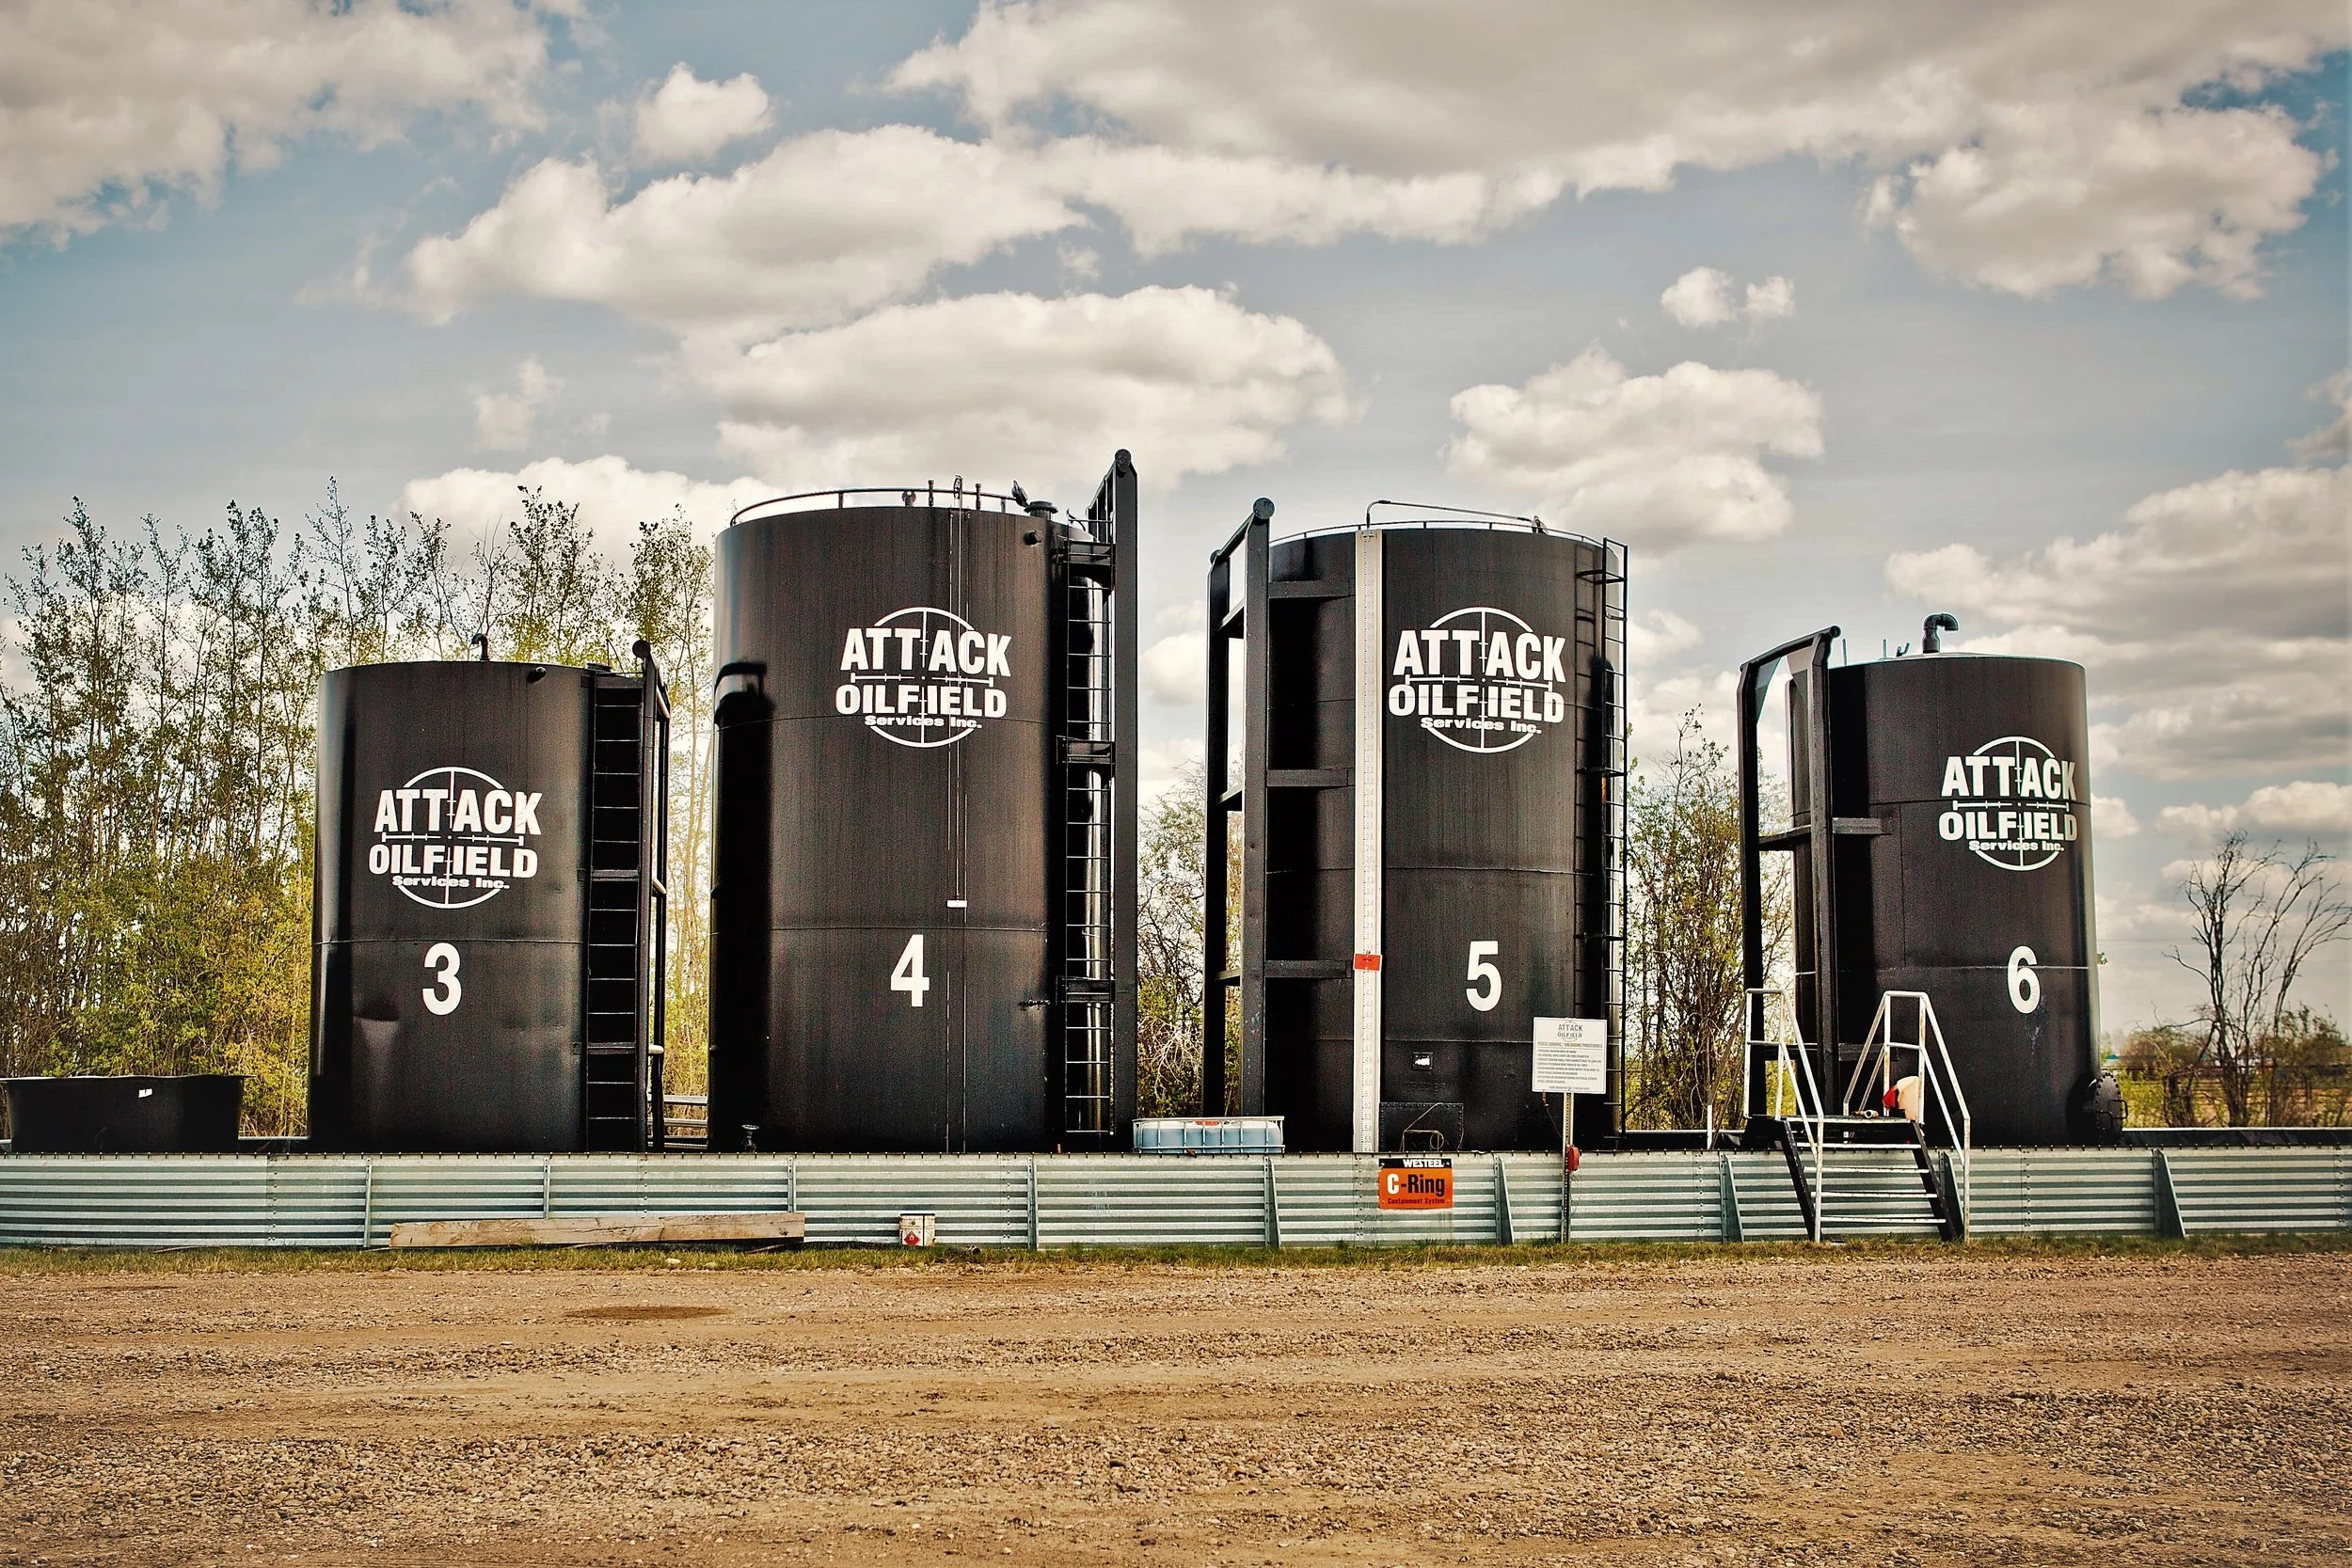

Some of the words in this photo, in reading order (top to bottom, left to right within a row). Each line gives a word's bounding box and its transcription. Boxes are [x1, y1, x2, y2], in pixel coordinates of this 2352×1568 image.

[840, 627, 1012, 677] ATTACK
[1392, 629, 1566, 683] ATTACK
[835, 684, 1007, 718] OILFIELD
[1389, 684, 1565, 723] OILFIELD
[865, 715, 945, 726] Services
[950, 717, 982, 729] Inc.
[1421, 717, 1504, 731] Services
[1511, 721, 1542, 735] Inc.
[1941, 755, 2077, 800] ATTACK
[373, 788, 543, 835] ATTACK
[1938, 811, 2078, 841] OILFIELD
[368, 844, 538, 879] OILFIELD
[1968, 840, 2039, 851] Services
[2042, 841, 2065, 851] Inc.
[392, 875, 470, 887] Services
[475, 878, 511, 889] Inc.
[422, 942, 461, 1015] 3
[891, 935, 930, 1006] 4
[1467, 941, 1502, 1011] 5
[2008, 946, 2040, 1014] 6
[1403, 1159, 1444, 1168] WESTEEL
[1387, 1173, 1445, 1197] C-Ring
